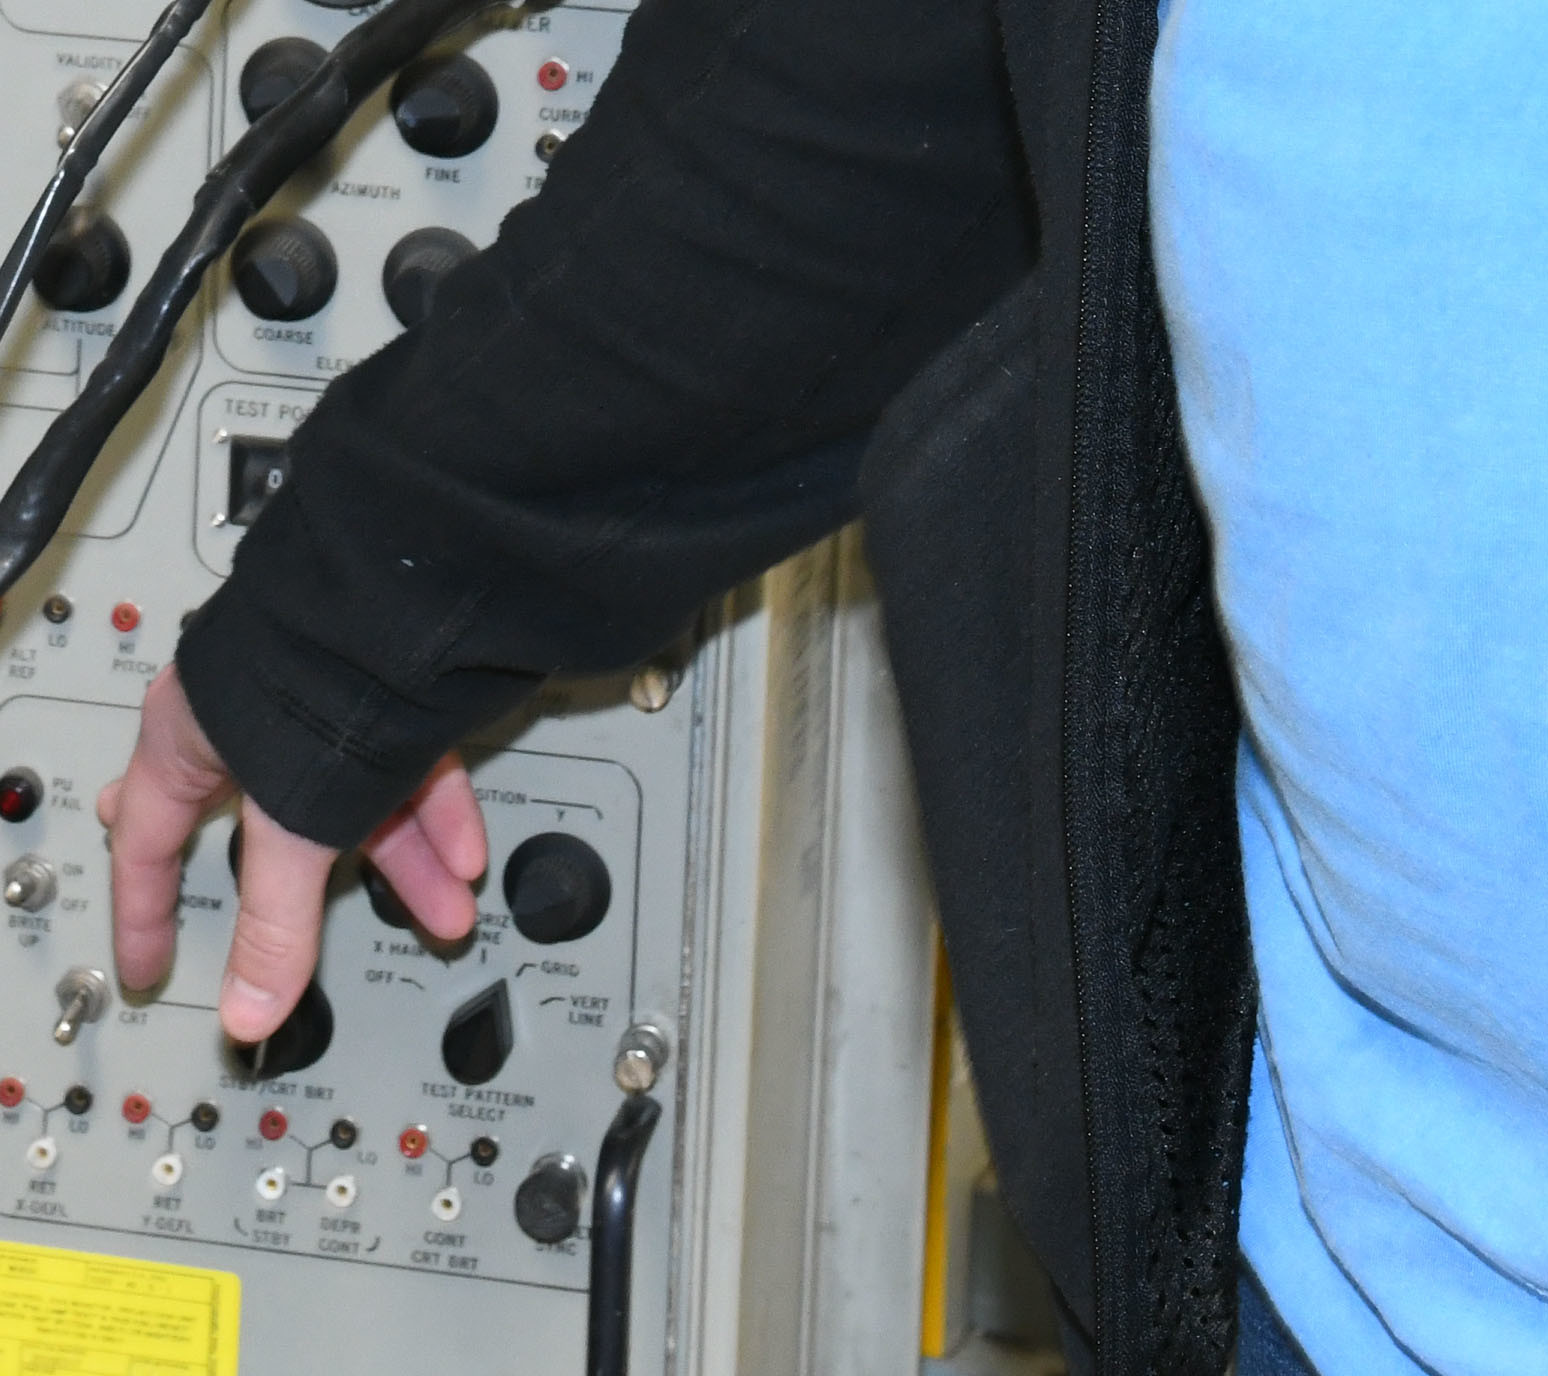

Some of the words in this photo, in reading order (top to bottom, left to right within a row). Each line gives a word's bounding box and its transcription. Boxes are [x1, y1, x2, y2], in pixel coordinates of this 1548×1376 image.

[425, 167, 461, 184] FINE
[331, 180, 401, 199] AZIMUTH
[254, 328, 314, 345] COARSE
[225, 399, 268, 419] TEST
[422, 1083, 459, 1099] TEST
[464, 1088, 535, 1108] PATTERN
[449, 1103, 506, 1122] SELECT
